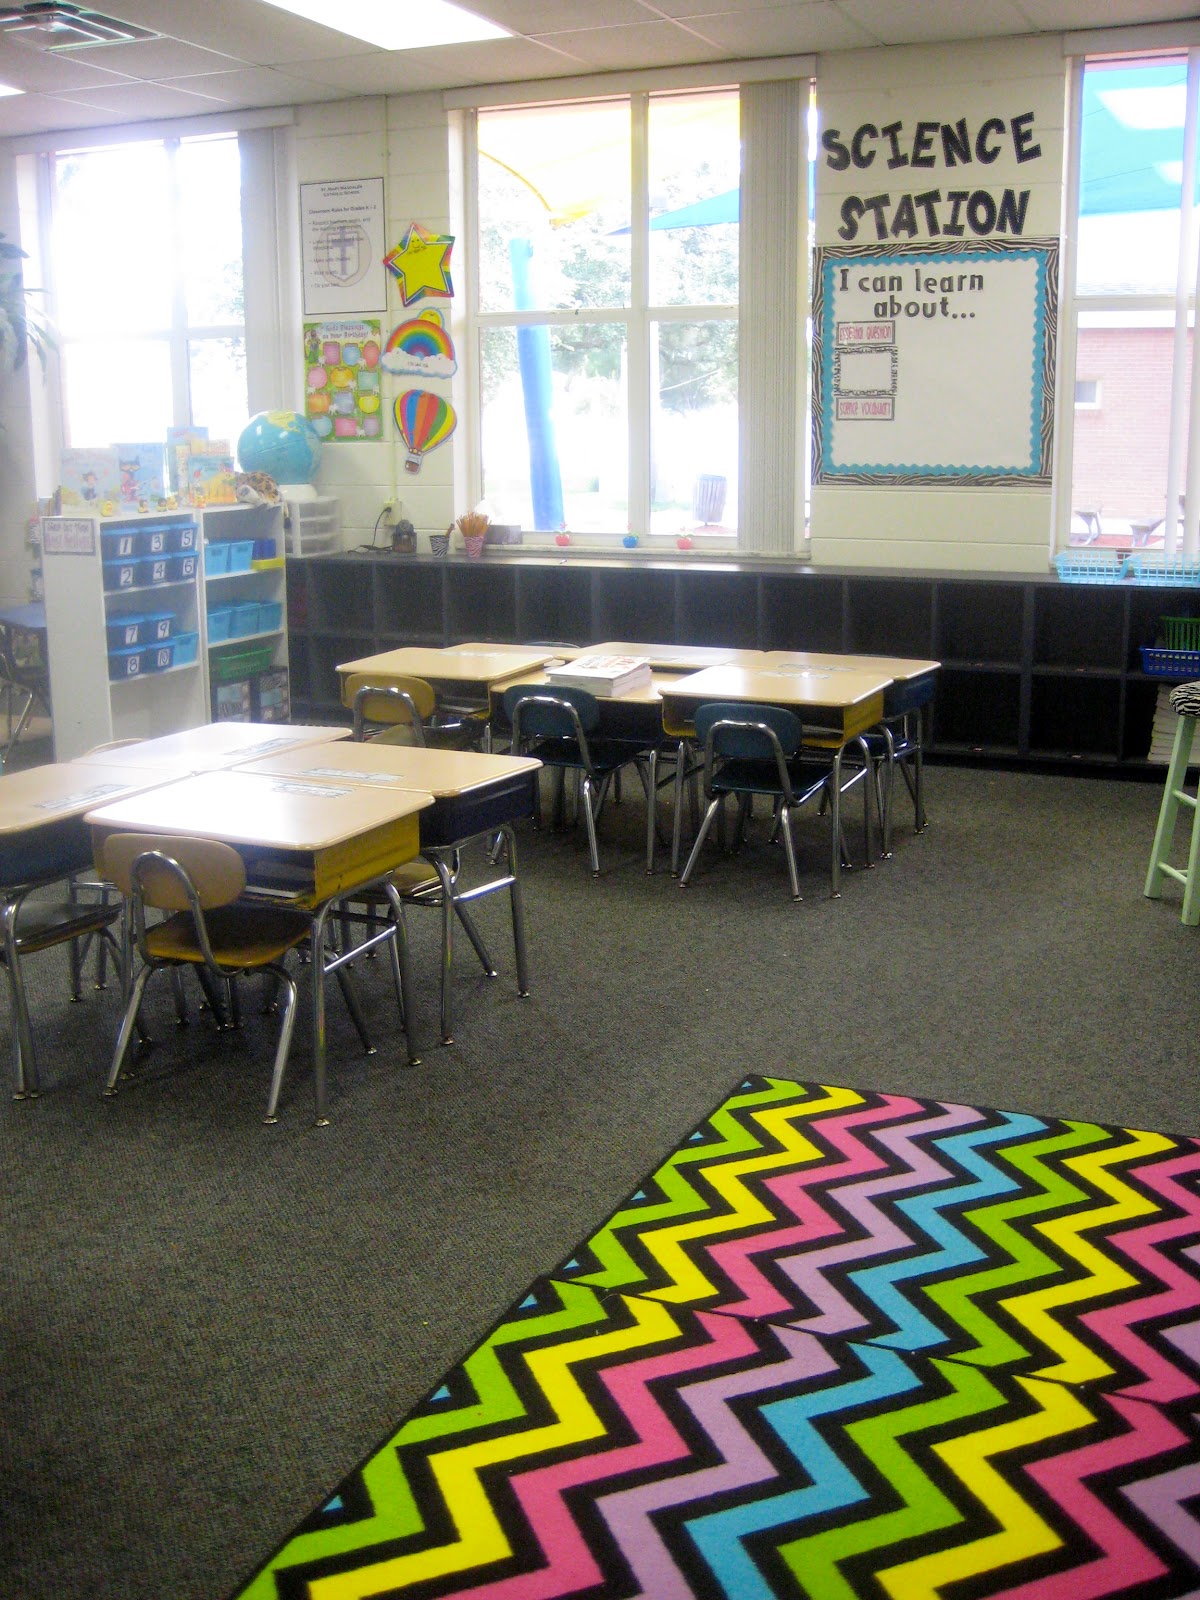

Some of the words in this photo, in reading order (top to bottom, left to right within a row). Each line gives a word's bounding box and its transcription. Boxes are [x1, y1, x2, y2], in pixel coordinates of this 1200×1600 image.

[822, 111, 1042, 171] SCIENCE
[837, 189, 1031, 241] STATION
[839, 268, 849, 292] I
[858, 274, 903, 293] can
[915, 268, 984, 294] learn
[873, 295, 976, 319] about...
[122, 537, 131, 554] 1
[154, 536, 162, 550] 3
[183, 531, 191, 546] 5
[154, 563, 165, 577] 4
[184, 560, 193, 573] 6
[122, 569, 132, 584] 2
[128, 627, 138, 642] 7
[160, 623, 168, 636] 9
[159, 651, 169, 664] 10
[130, 658, 138, 673] 8
